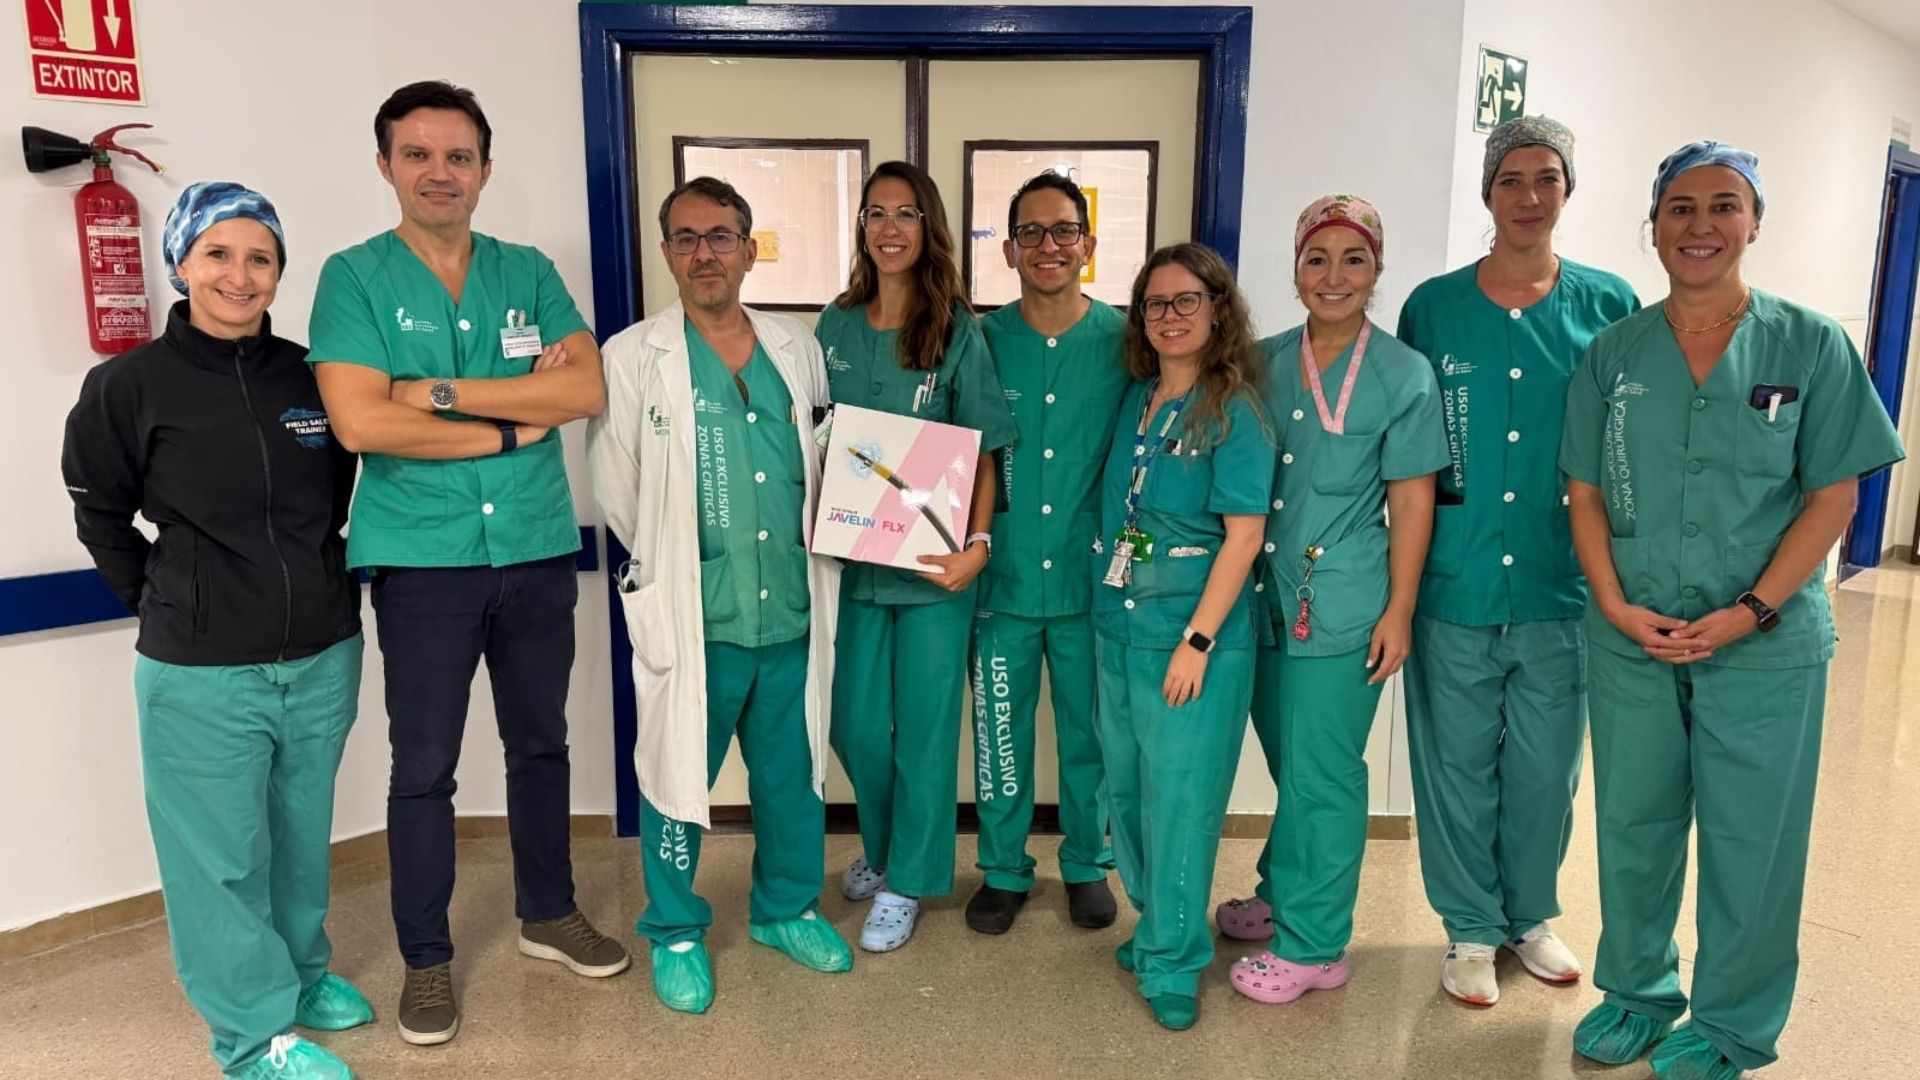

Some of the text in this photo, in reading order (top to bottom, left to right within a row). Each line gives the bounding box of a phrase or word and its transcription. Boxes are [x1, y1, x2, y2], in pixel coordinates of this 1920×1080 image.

[39, 62, 135, 94] EXTINTOR
[1444, 389, 1457, 432] ZONAS
[1458, 386, 1468, 414] USO
[697, 425, 711, 469] ZONAS
[713, 426, 725, 454] USO
[1614, 401, 1637, 520] ZONA QUIRÚRGICA
[716, 457, 730, 528] EXCLUSIVO
[827, 511, 906, 533] JAVELIN FLX
[991, 657, 1018, 796] USO EXCLUSIVO
